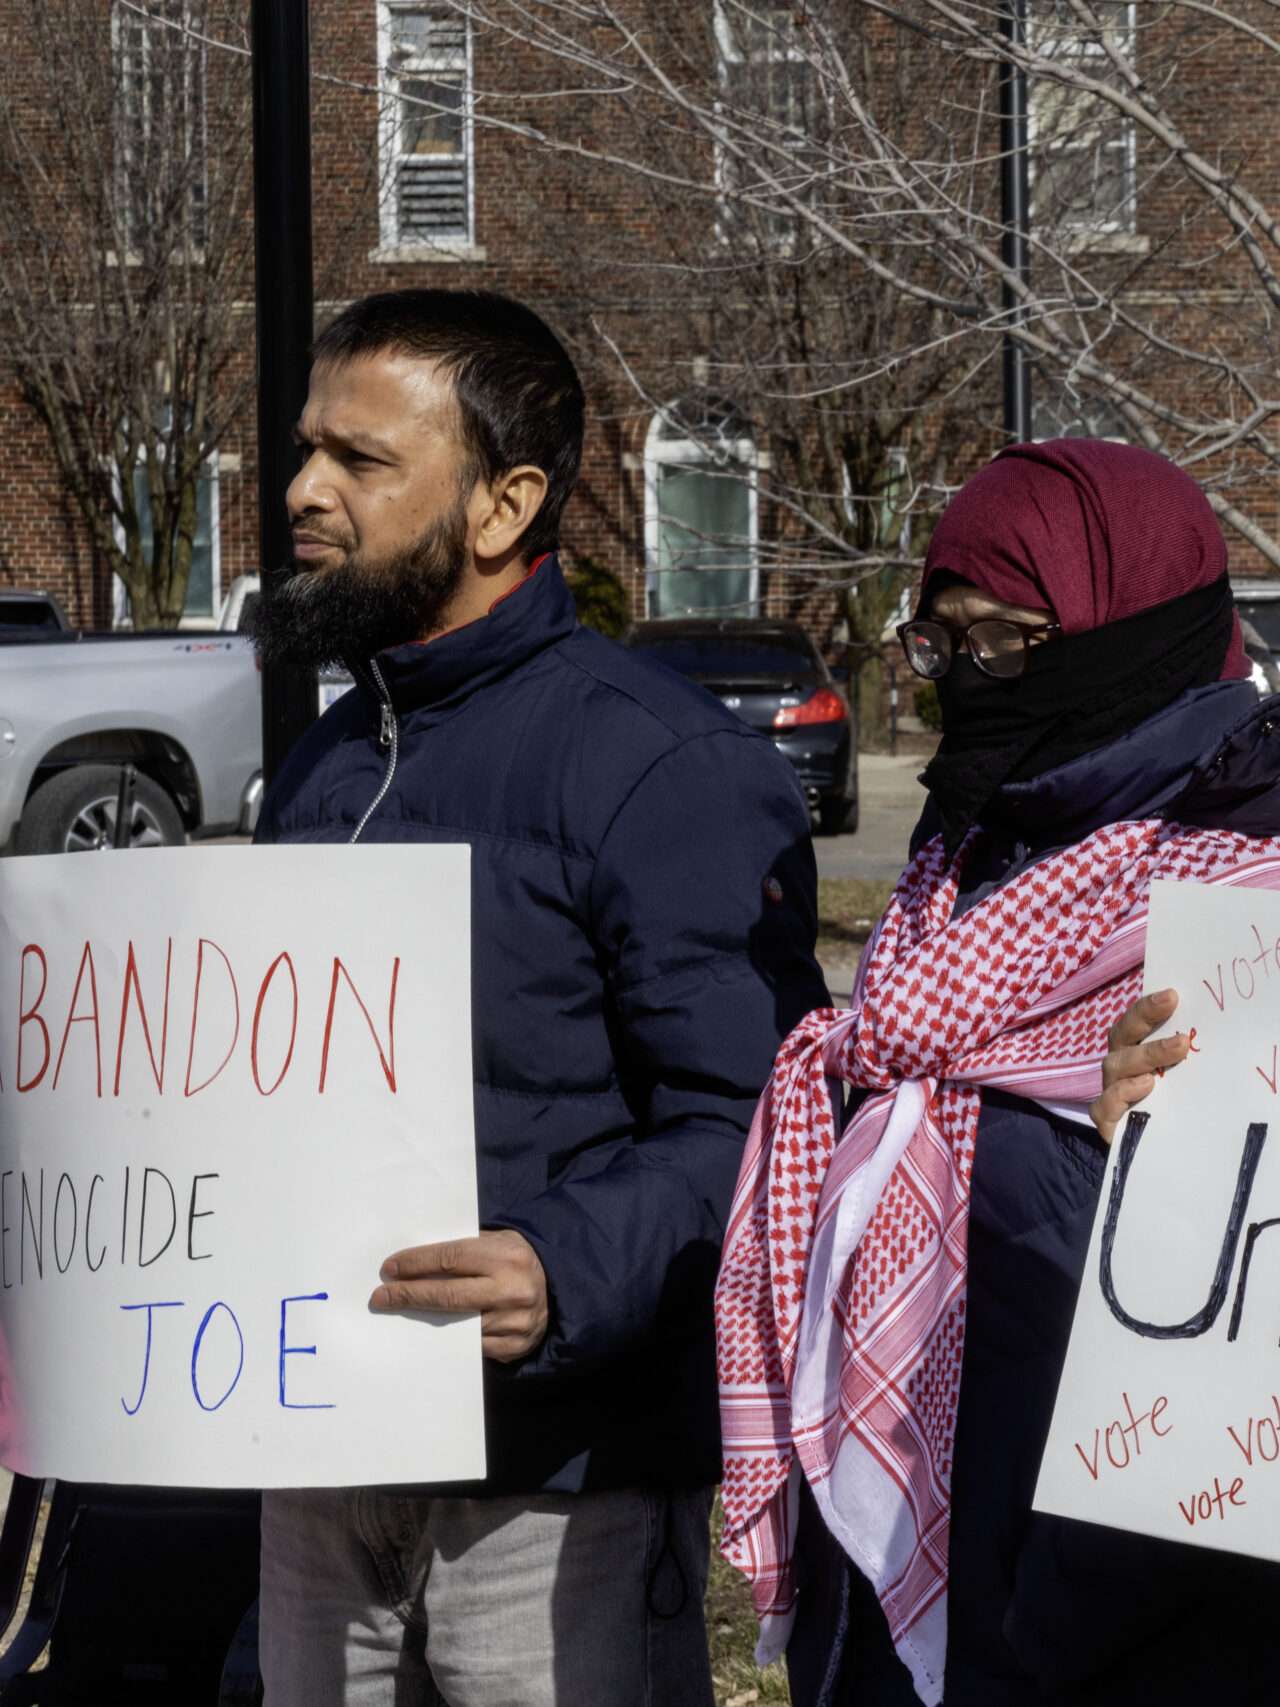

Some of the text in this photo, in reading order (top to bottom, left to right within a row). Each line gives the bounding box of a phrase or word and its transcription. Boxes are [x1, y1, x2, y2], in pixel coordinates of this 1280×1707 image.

[0, 937, 402, 1099] BANDON
[121, 1293, 337, 1416] JOE
[1075, 1392, 1173, 1481] vote
[1178, 1476, 1246, 1526] vote
